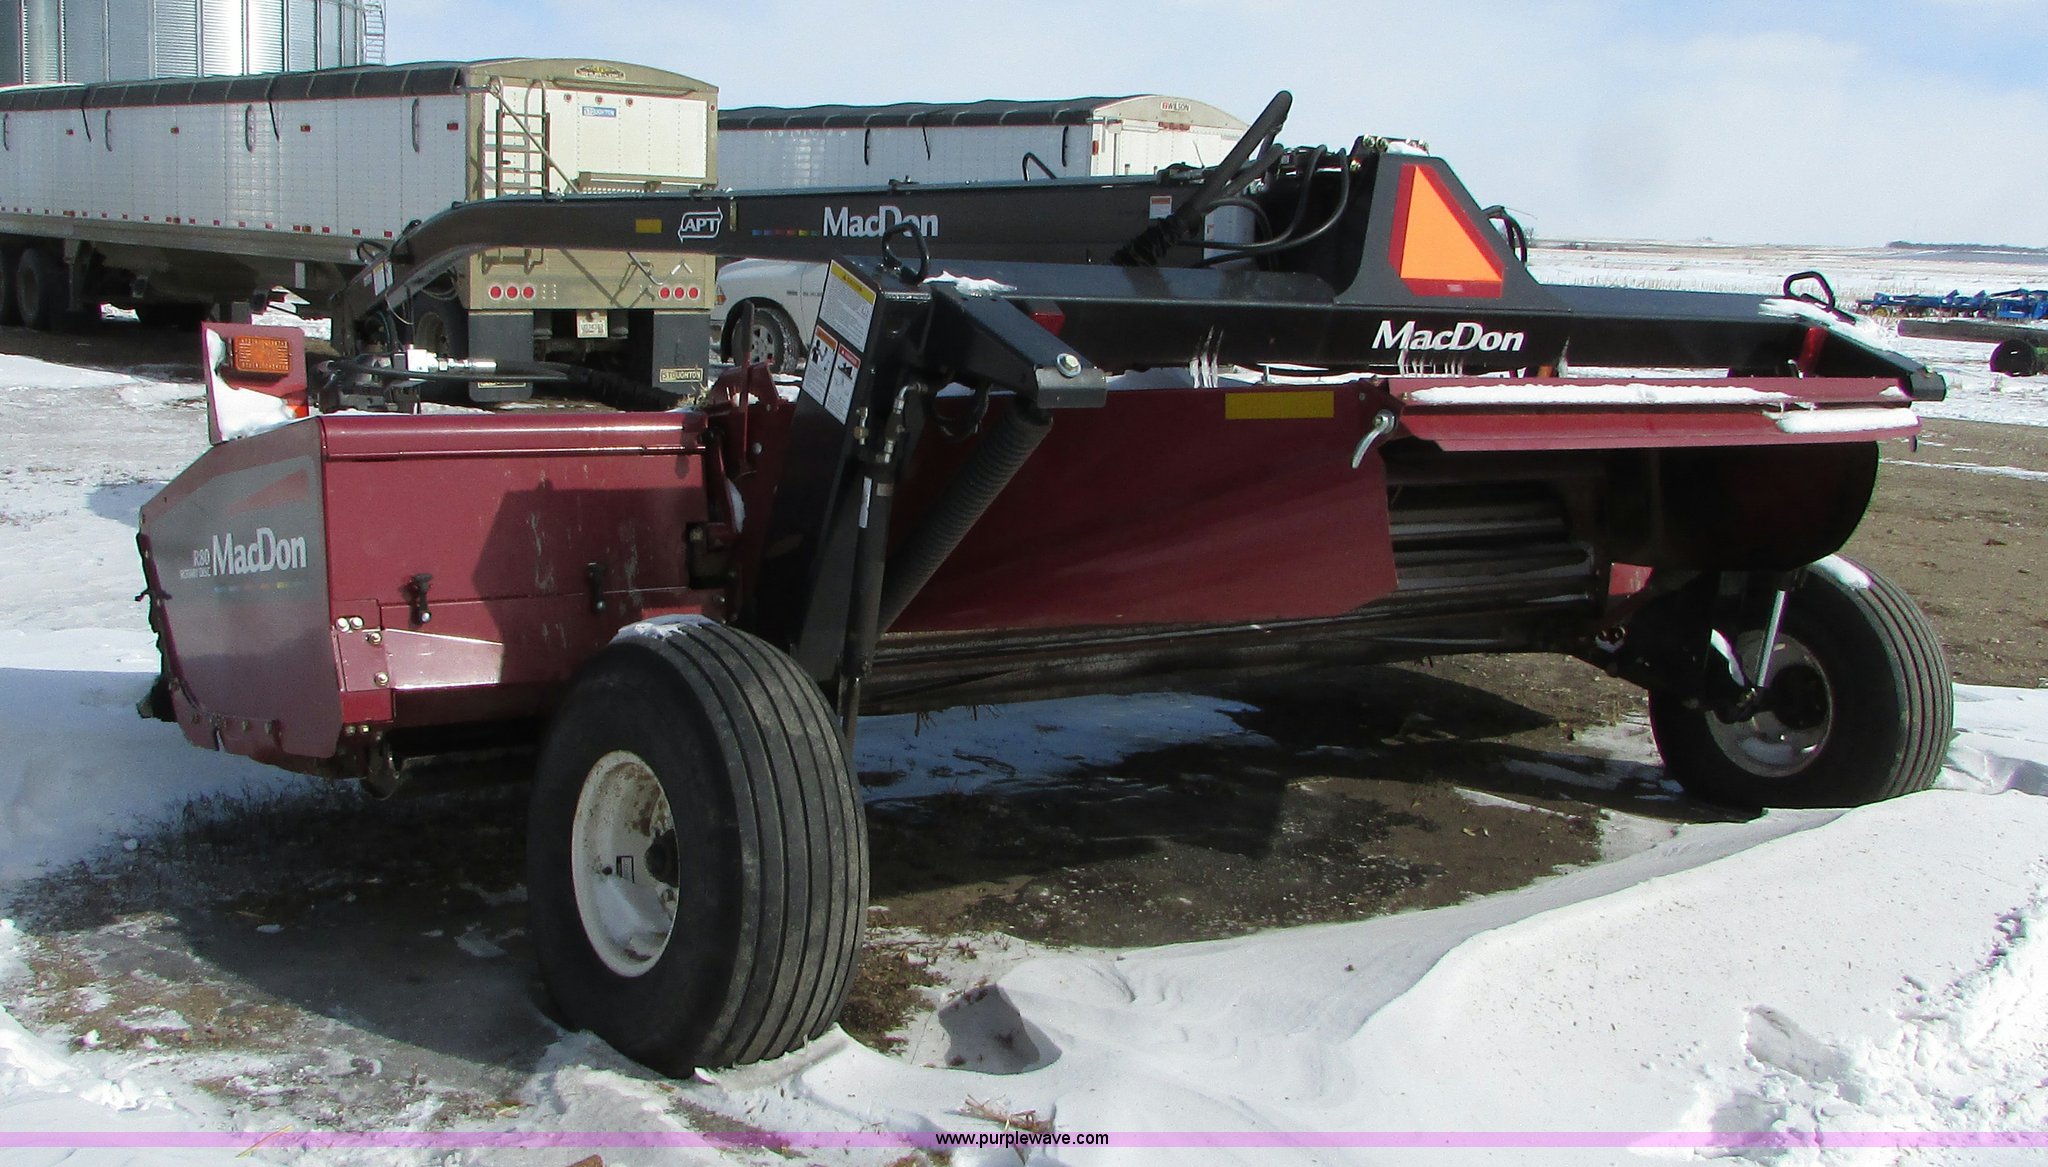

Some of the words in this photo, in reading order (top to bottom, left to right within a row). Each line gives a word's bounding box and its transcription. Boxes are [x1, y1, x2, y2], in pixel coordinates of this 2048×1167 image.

[684, 217, 717, 233] APT
[1371, 320, 1525, 351] MacDon
[662, 370, 701, 380] STOUGHTON
[212, 527, 307, 576] MacDon
